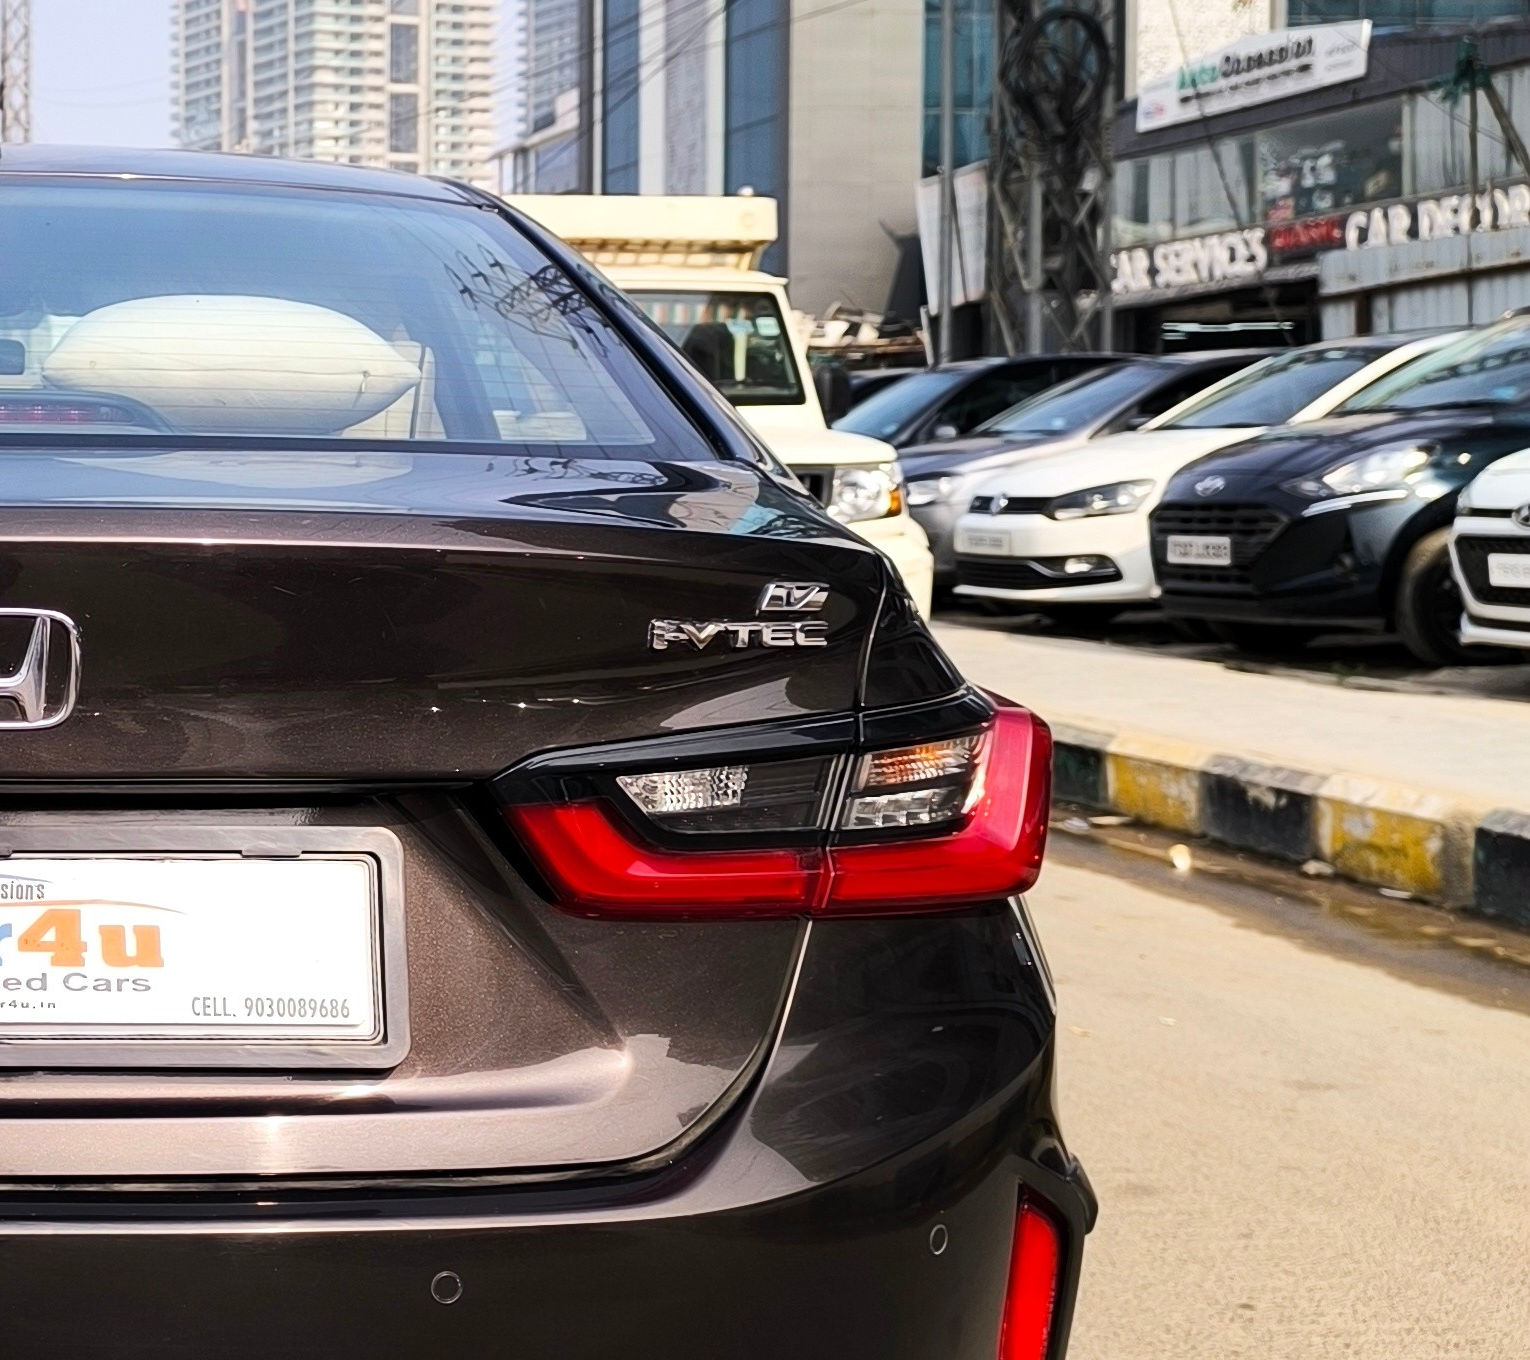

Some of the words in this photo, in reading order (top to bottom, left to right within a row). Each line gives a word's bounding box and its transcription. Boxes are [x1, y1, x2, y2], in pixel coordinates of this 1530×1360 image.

[1345, 204, 1410, 251] CAR
[1108, 247, 1152, 293] AR
[62, 972, 152, 993] Cars
[244, 997, 350, 1019] 9030089686
